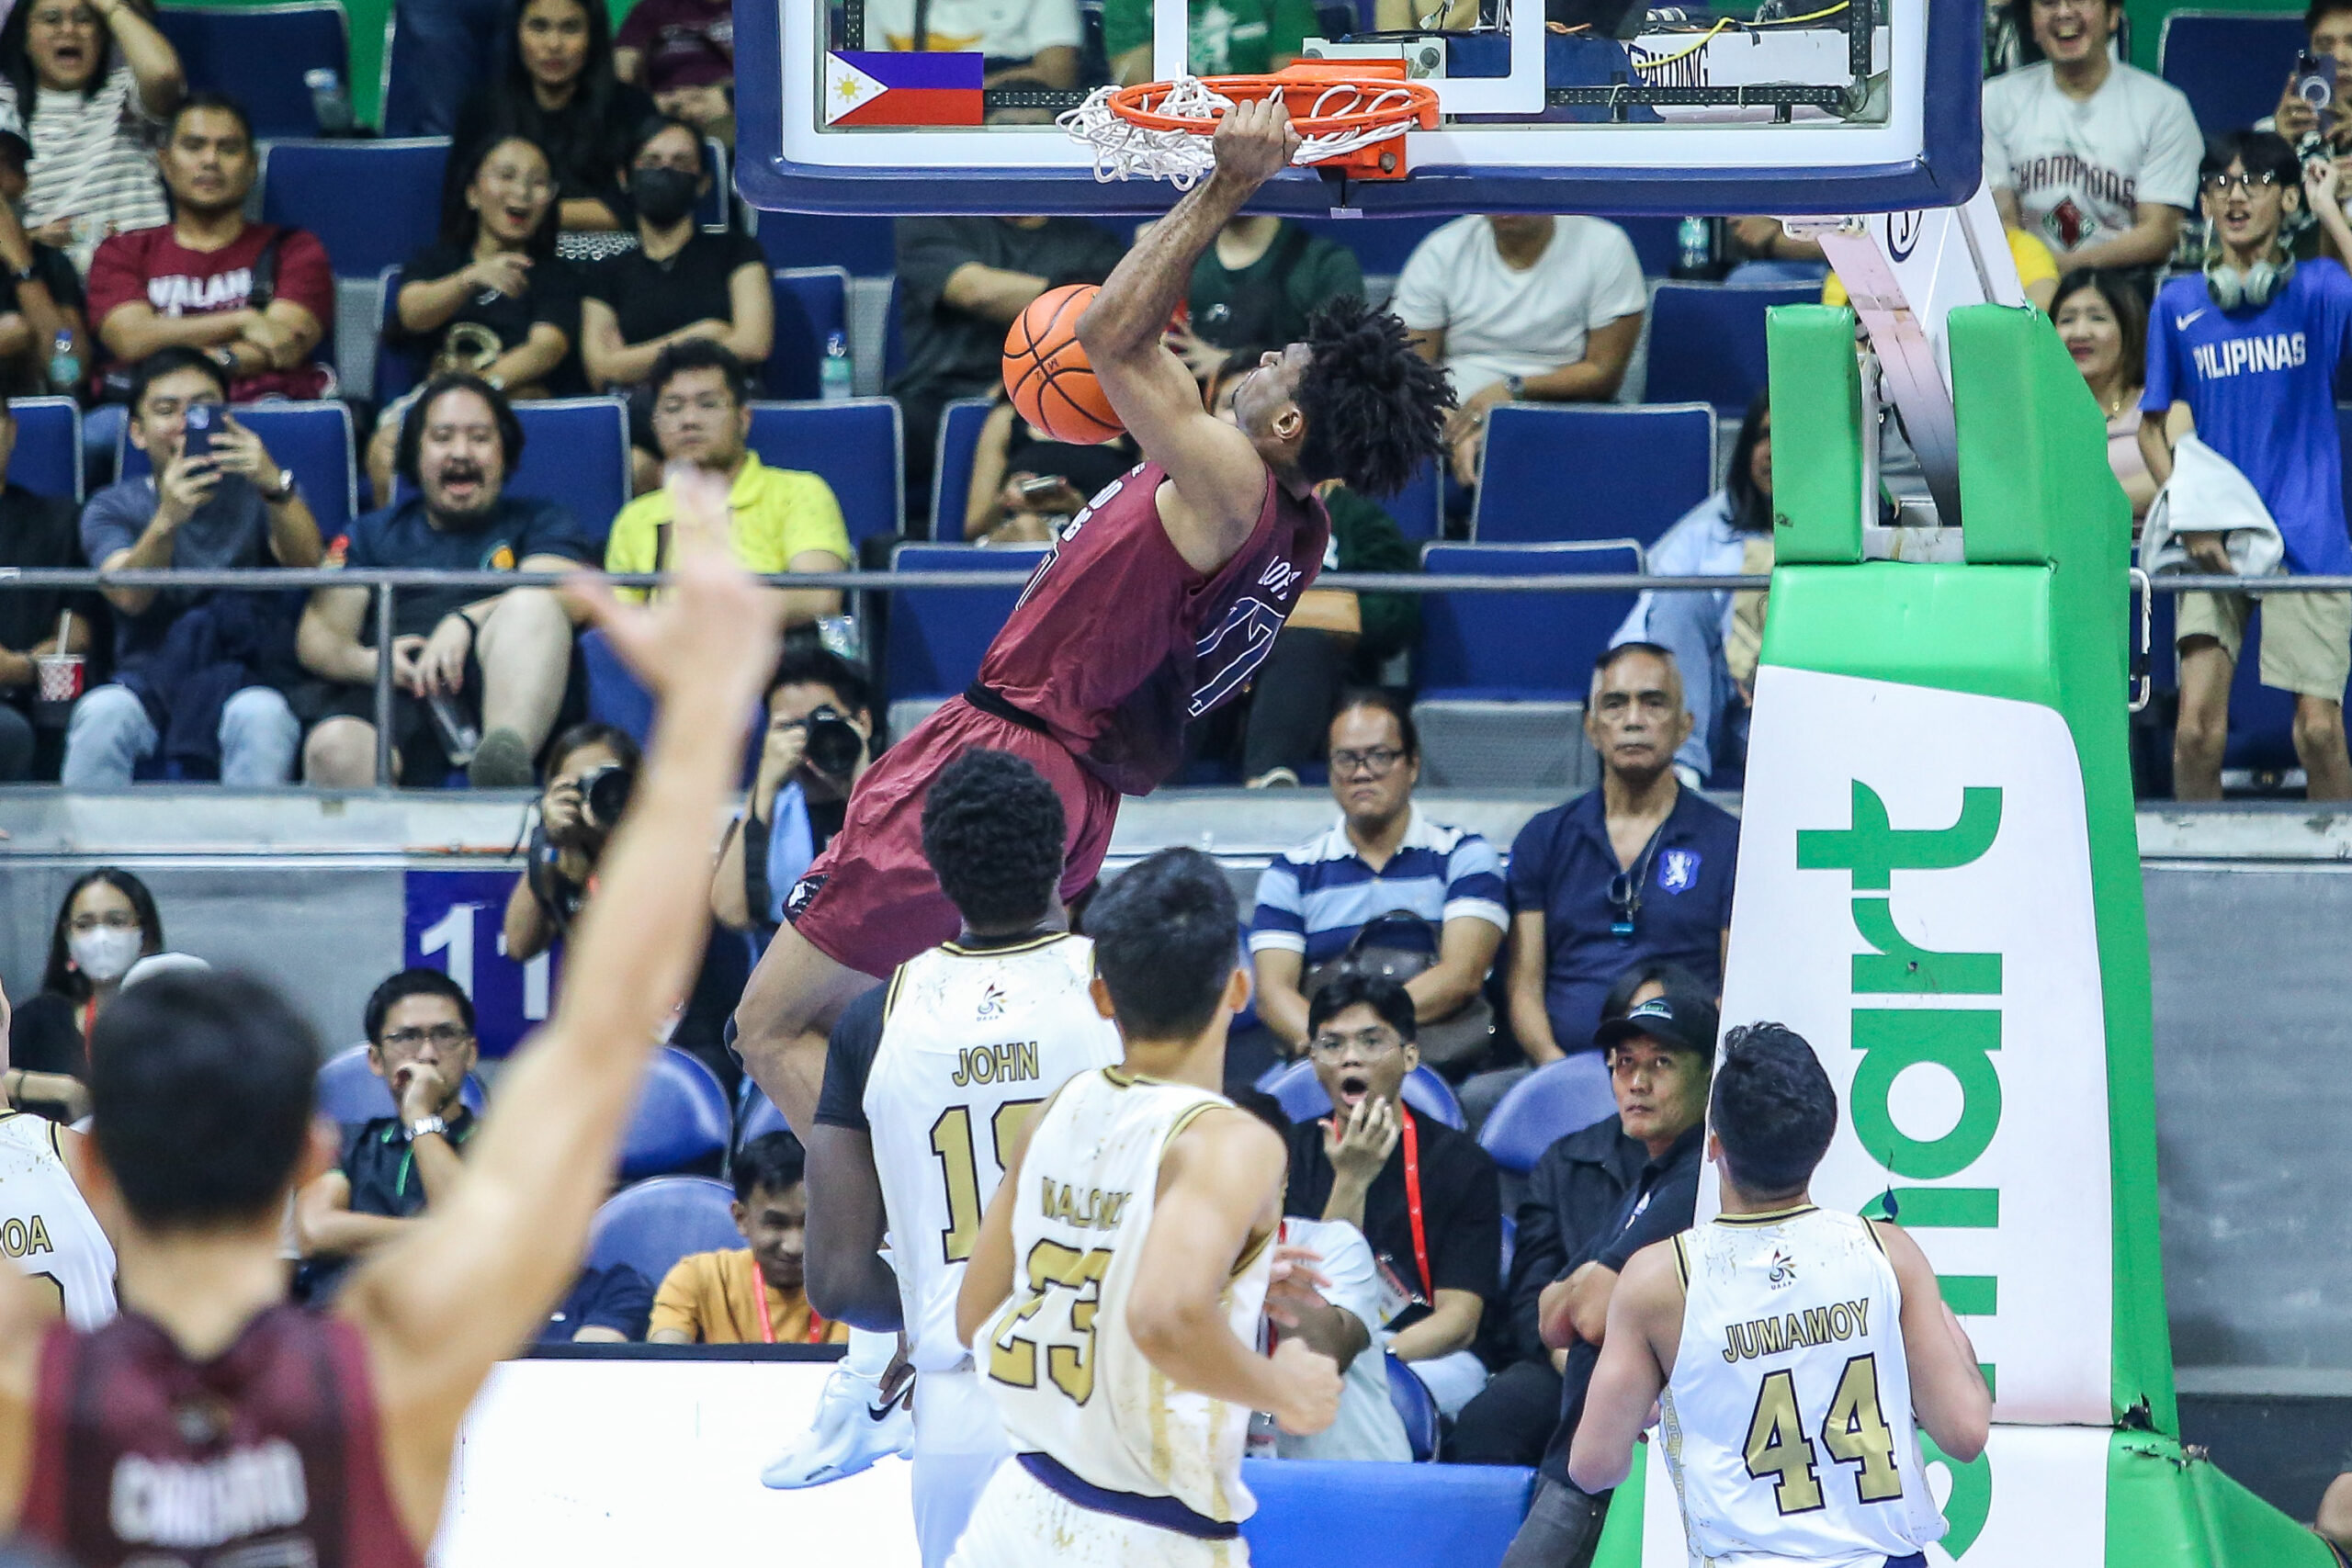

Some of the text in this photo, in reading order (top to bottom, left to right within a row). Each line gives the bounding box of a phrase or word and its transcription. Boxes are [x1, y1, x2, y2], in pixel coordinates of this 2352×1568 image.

[2192, 332, 2307, 382] PILIPINAS
[952, 1041, 1040, 1088] JOHN
[0, 1214, 54, 1258] OA
[989, 1237, 1116, 1407] 23
[1722, 1297, 1869, 1364] JUMAMOY
[1742, 1351, 1904, 1516] 44
